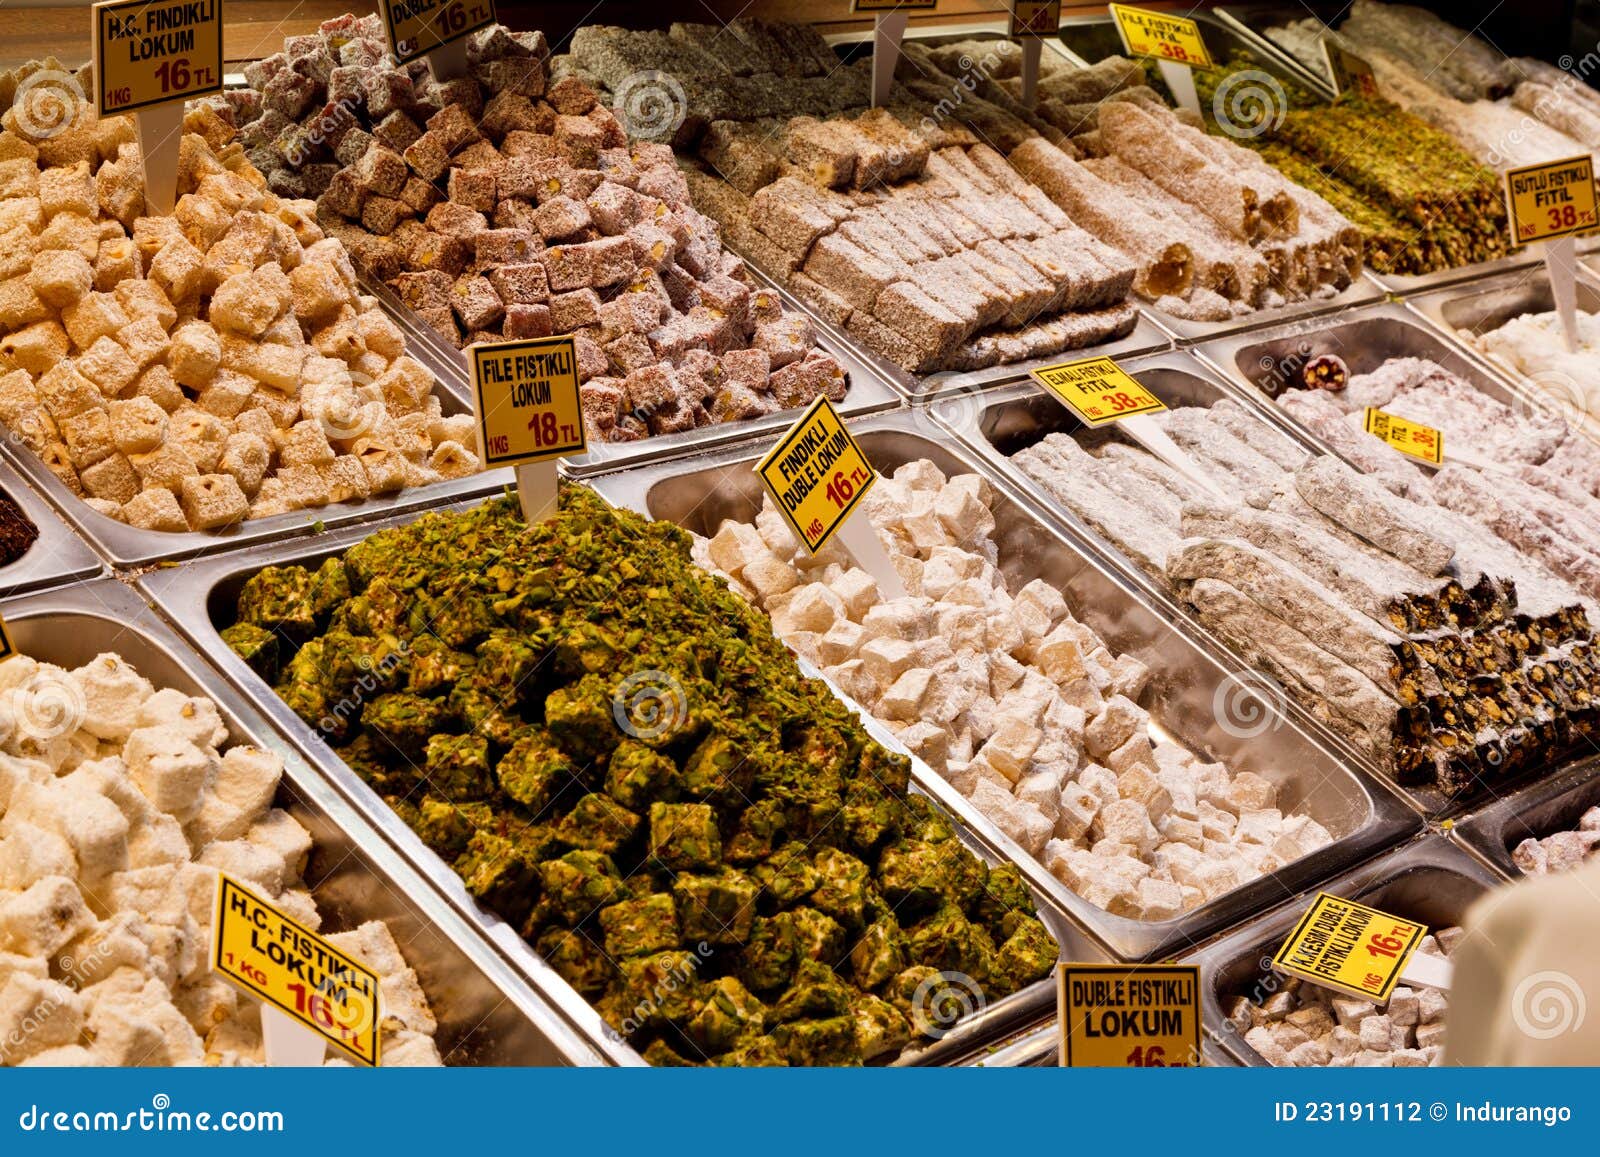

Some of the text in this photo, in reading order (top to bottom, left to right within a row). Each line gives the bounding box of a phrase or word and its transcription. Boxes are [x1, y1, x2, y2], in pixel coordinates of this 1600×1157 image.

[108, 0, 215, 41] H.C. FINDIKLI
[435, 1, 489, 37] 16 TL
[129, 29, 195, 62] LOKUM
[1158, 42, 1188, 61] 38
[154, 58, 215, 93] 16 TL
[107, 87, 131, 106] 1KG
[1547, 204, 1577, 231] 38
[515, 351, 572, 381] FISTIKLI
[511, 380, 552, 408] LOKUM
[1102, 392, 1155, 412] 38 TL
[489, 434, 509, 455] 1KG
[527, 411, 580, 447] 18 TL
[777, 418, 830, 483] FINDIKLI
[782, 429, 850, 513] DUBLE LOKUM
[825, 466, 869, 510] 16 TL
[805, 517, 824, 543] 1KG
[1313, 902, 1349, 933] DUBLE
[230, 891, 369, 998] H.C. FISTIKLI
[1314, 908, 1374, 978] FISTIKLI LOKUM
[1366, 924, 1413, 959] 16 TL
[251, 929, 349, 1009] LOKUM
[1362, 972, 1384, 990] 1KG
[286, 981, 335, 1029] 16
[1072, 979, 1192, 1007] DUBLE FISTIKLI
[1085, 1009, 1183, 1038] LOKUM
